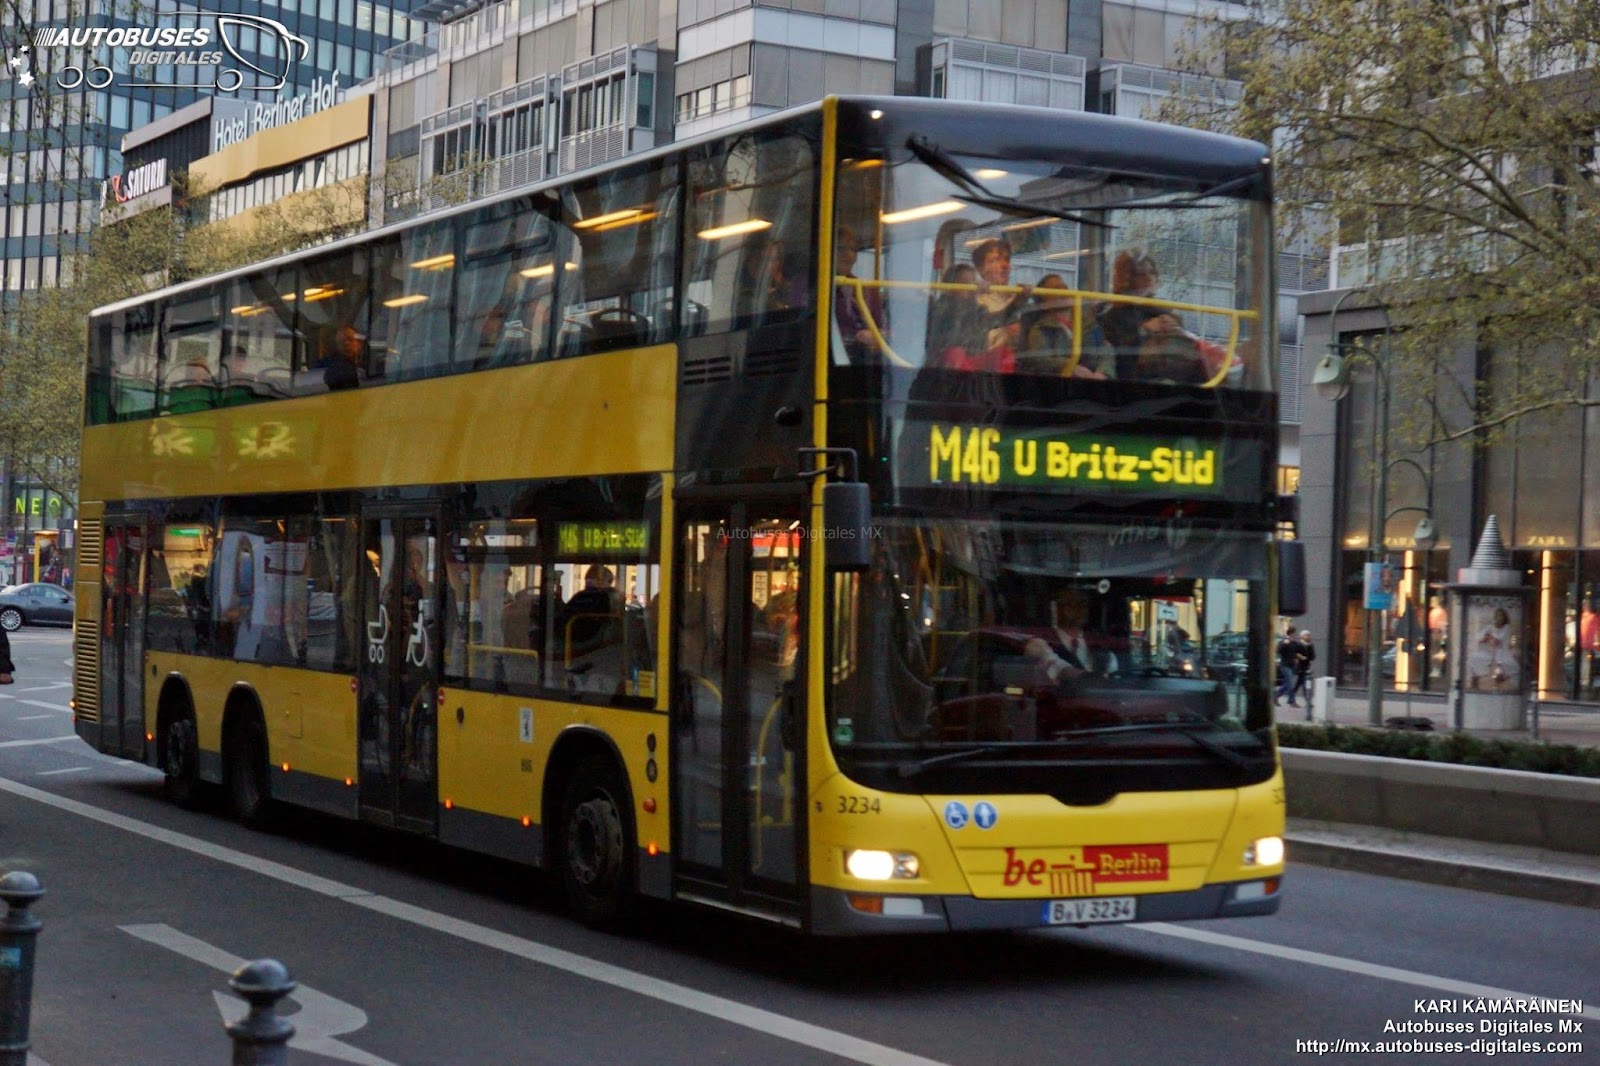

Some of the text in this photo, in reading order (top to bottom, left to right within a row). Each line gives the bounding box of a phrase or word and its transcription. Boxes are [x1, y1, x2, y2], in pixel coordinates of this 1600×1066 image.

[214, 69, 340, 152] Hotel Berliner Hof
[127, 157, 167, 200] SATURN
[930, 424, 1215, 486] M46 U Britz-Süd
[1527, 535, 1565, 546] ZARA
[837, 796, 881, 814] 3234
[1004, 847, 1161, 886] be Berlin
[1089, 900, 1131, 918] 3234
